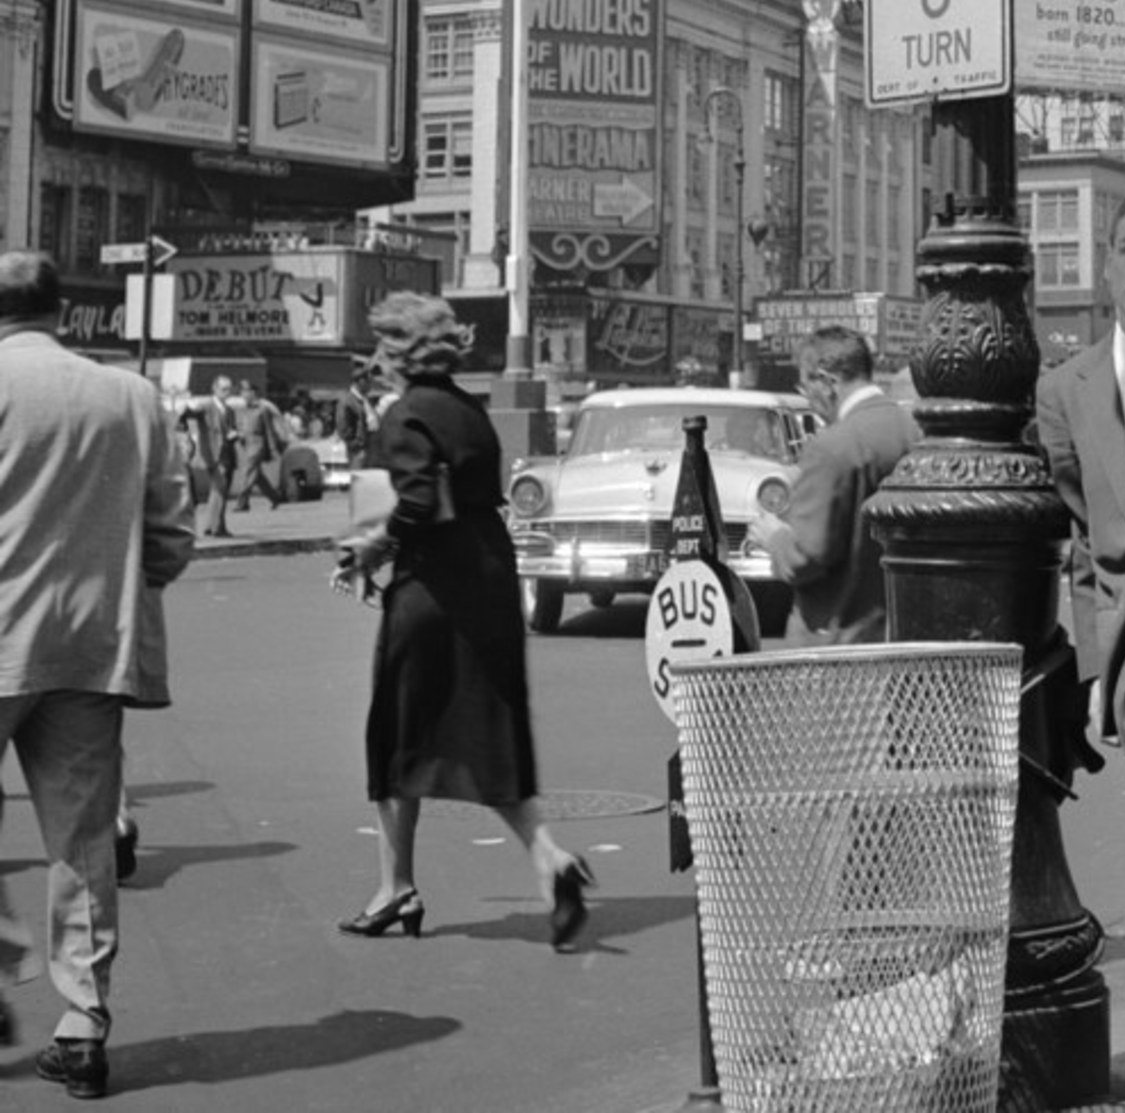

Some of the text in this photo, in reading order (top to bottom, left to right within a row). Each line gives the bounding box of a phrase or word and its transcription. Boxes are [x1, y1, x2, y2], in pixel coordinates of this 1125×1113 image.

[1036, 3, 1069, 22] born
[902, 27, 972, 70] TURN
[528, 67, 558, 91] HE
[559, 42, 652, 98] WORLD
[954, 70, 998, 84] TRAFFIC
[530, 126, 651, 171] INERAMA
[530, 177, 591, 201] ARNER
[180, 266, 294, 302] DEBUT
[179, 310, 289, 326] TOM HELMORE
[672, 515, 704, 533] POLICE
[658, 580, 718, 630] BUS
